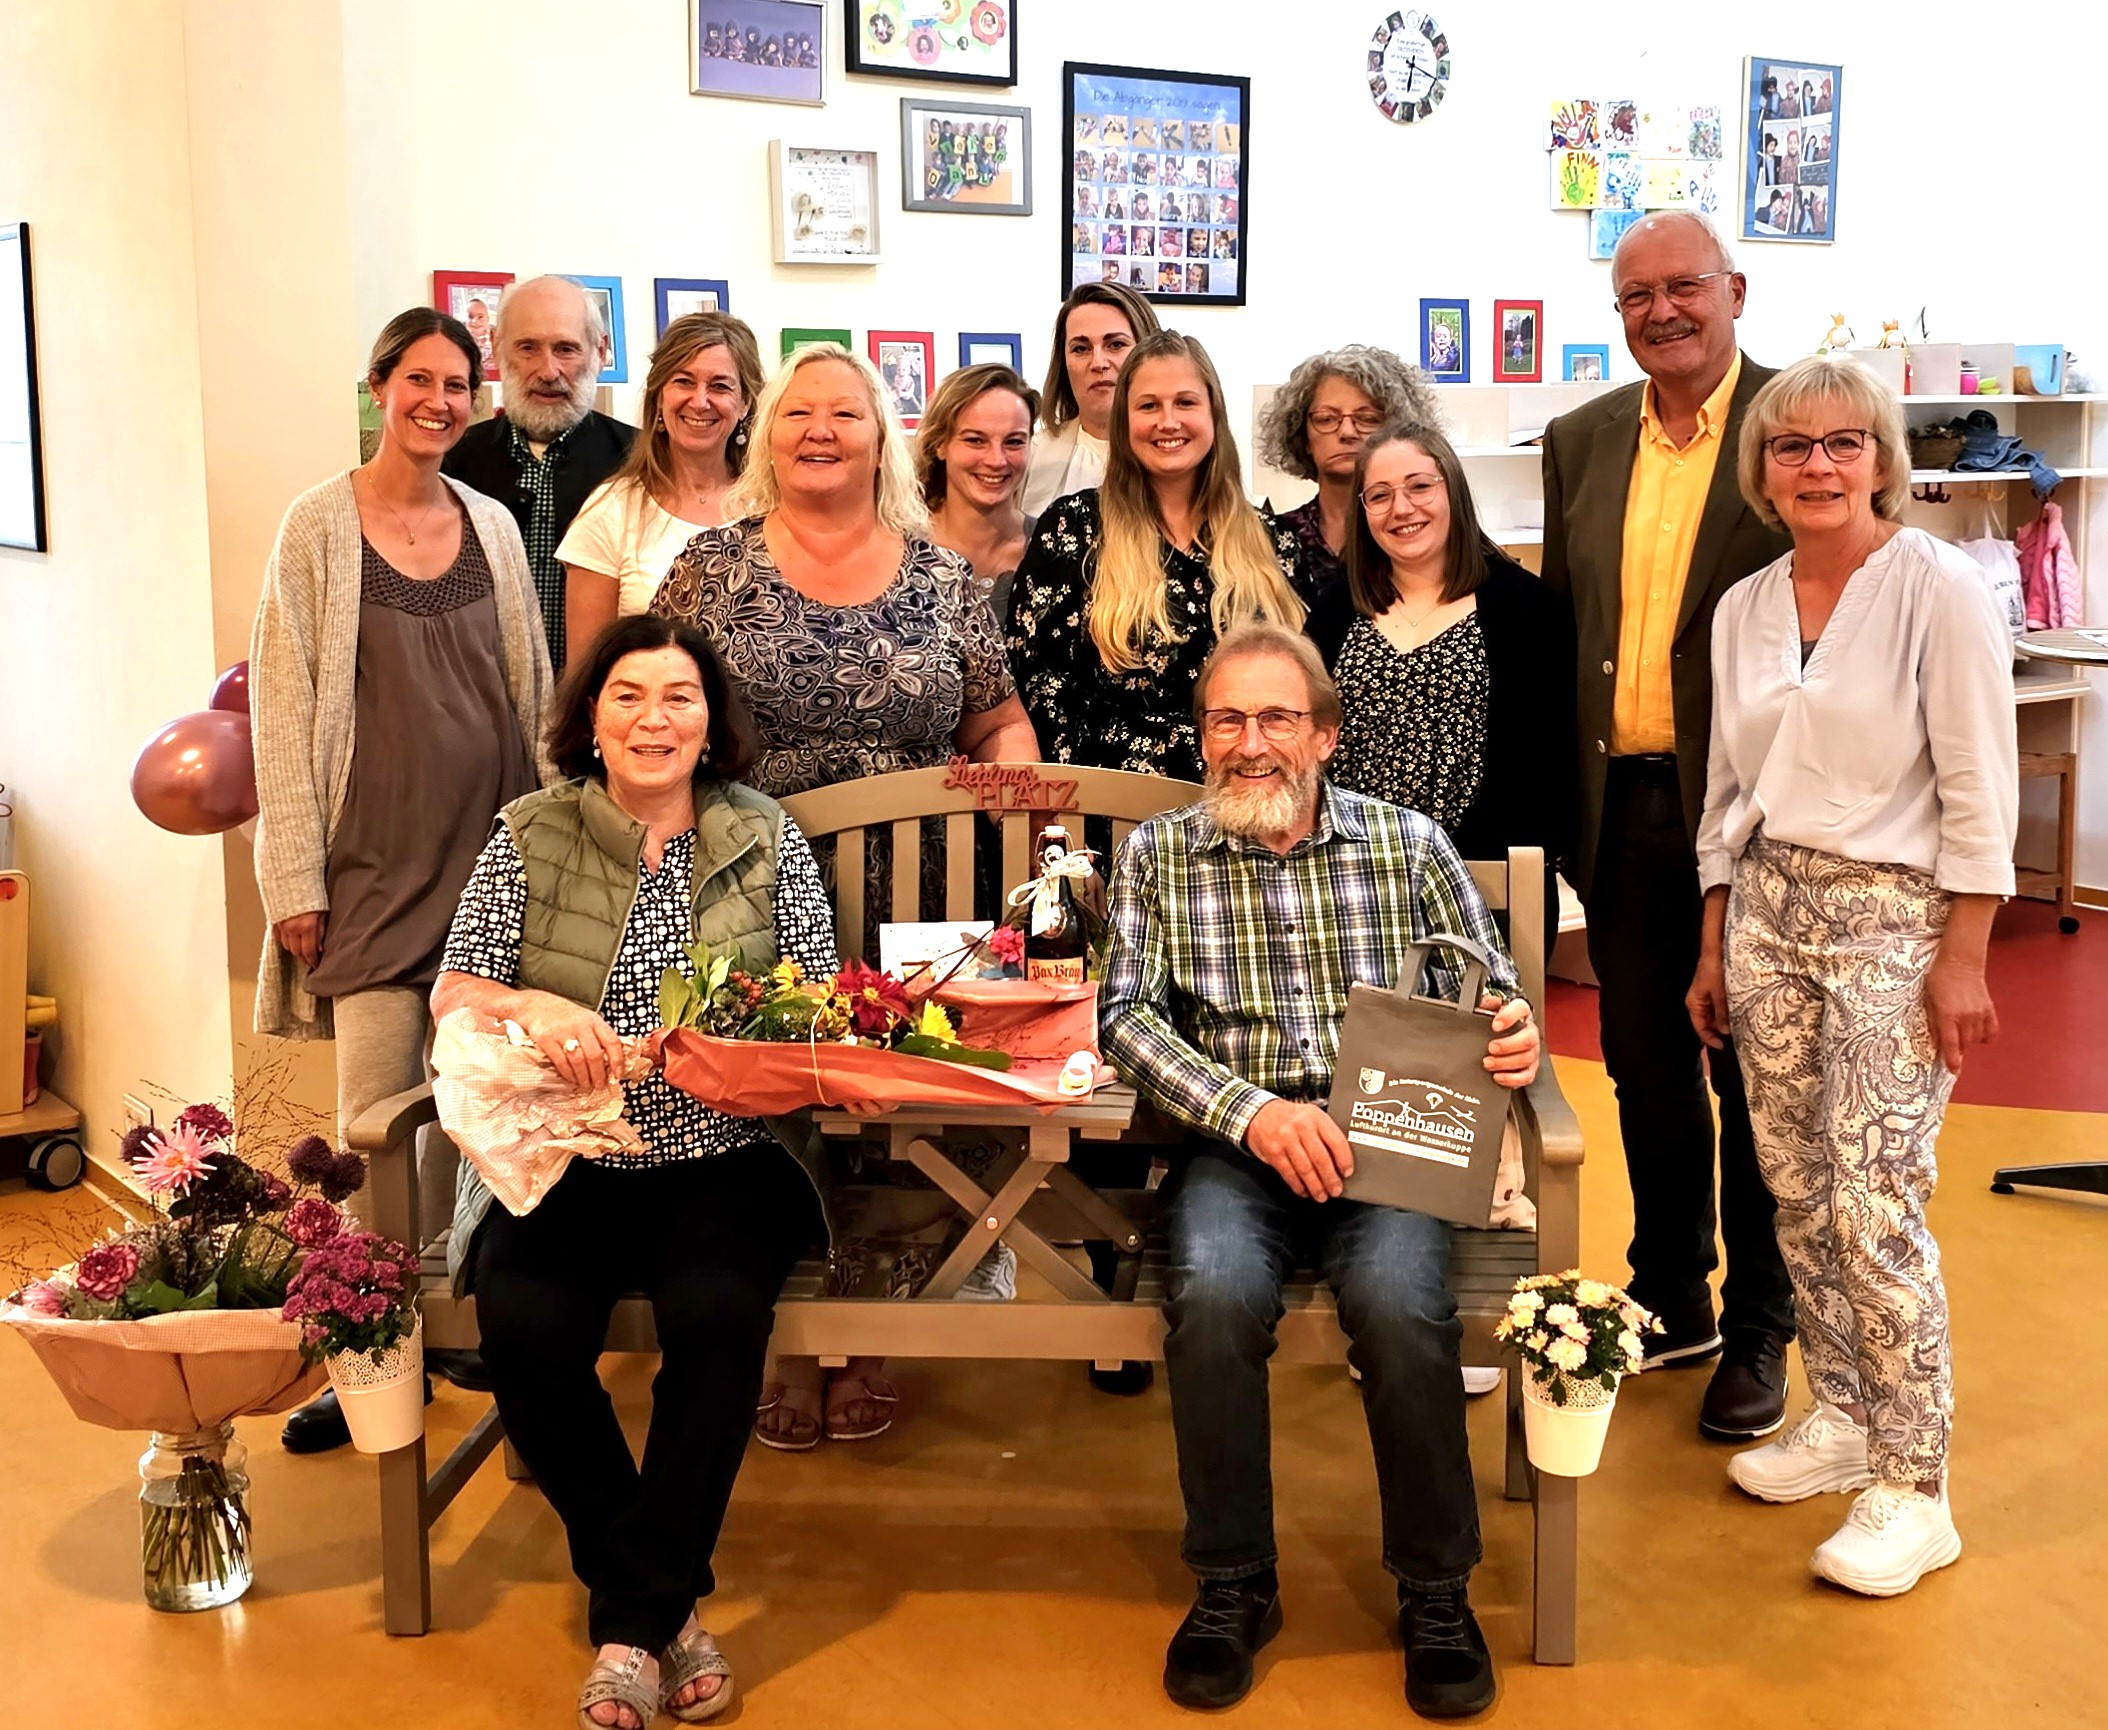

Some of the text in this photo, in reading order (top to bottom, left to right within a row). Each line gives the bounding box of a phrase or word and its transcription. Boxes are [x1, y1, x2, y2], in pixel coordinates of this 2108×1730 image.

[1567, 152, 1600, 169] FINN
[1031, 965, 1053, 981] Pax
[1352, 1101, 1475, 1142] Poppenhausen
[1350, 1120, 1472, 1154] Luftkurort an der Wasserkuppe
